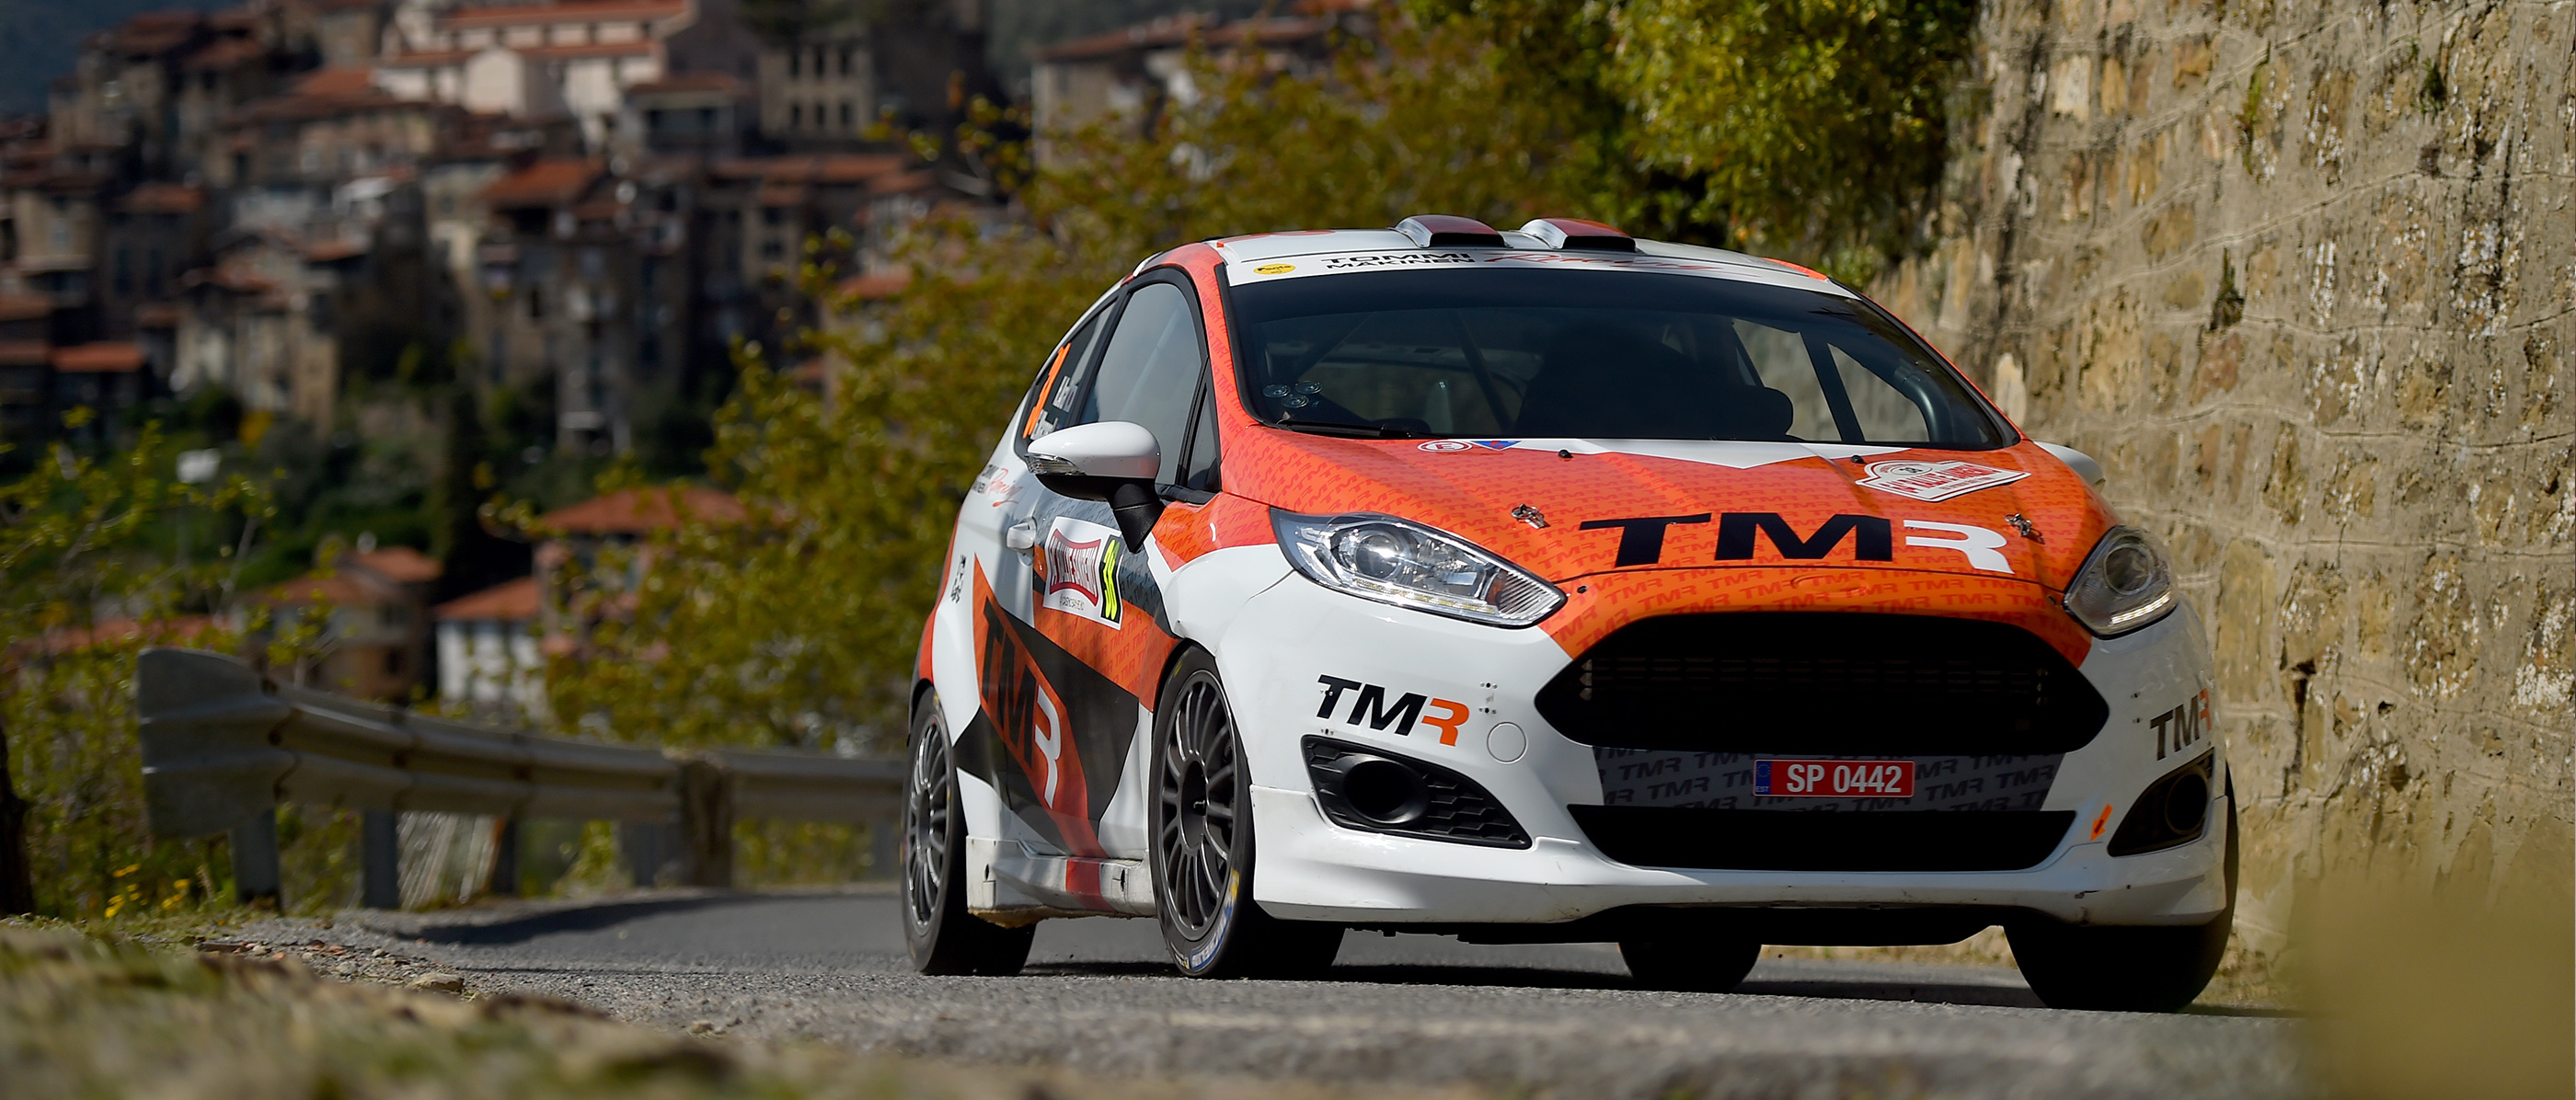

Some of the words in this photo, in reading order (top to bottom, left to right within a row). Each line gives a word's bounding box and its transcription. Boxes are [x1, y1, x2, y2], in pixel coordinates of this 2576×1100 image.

[1320, 253, 1472, 264] TOMMI
[1579, 512, 2015, 575] TMR
[1604, 578, 1662, 605] TMR
[1706, 569, 1764, 590] TMR
[1908, 579, 1966, 591] TMR
[1637, 585, 1696, 611] TMR
[1940, 593, 1998, 605] TMR
[982, 595, 1062, 809] TMR
[1317, 673, 1470, 748] TMR
[2149, 688, 2213, 762] TMR
[1619, 758, 1682, 781] TMR
[1786, 763, 1825, 794] SP
[1833, 764, 1903, 794] 0442
[1915, 758, 1959, 781] MR
[1995, 764, 2055, 789] TMR
[1648, 776, 1711, 800] TMR
[1925, 777, 1984, 802] TMR
